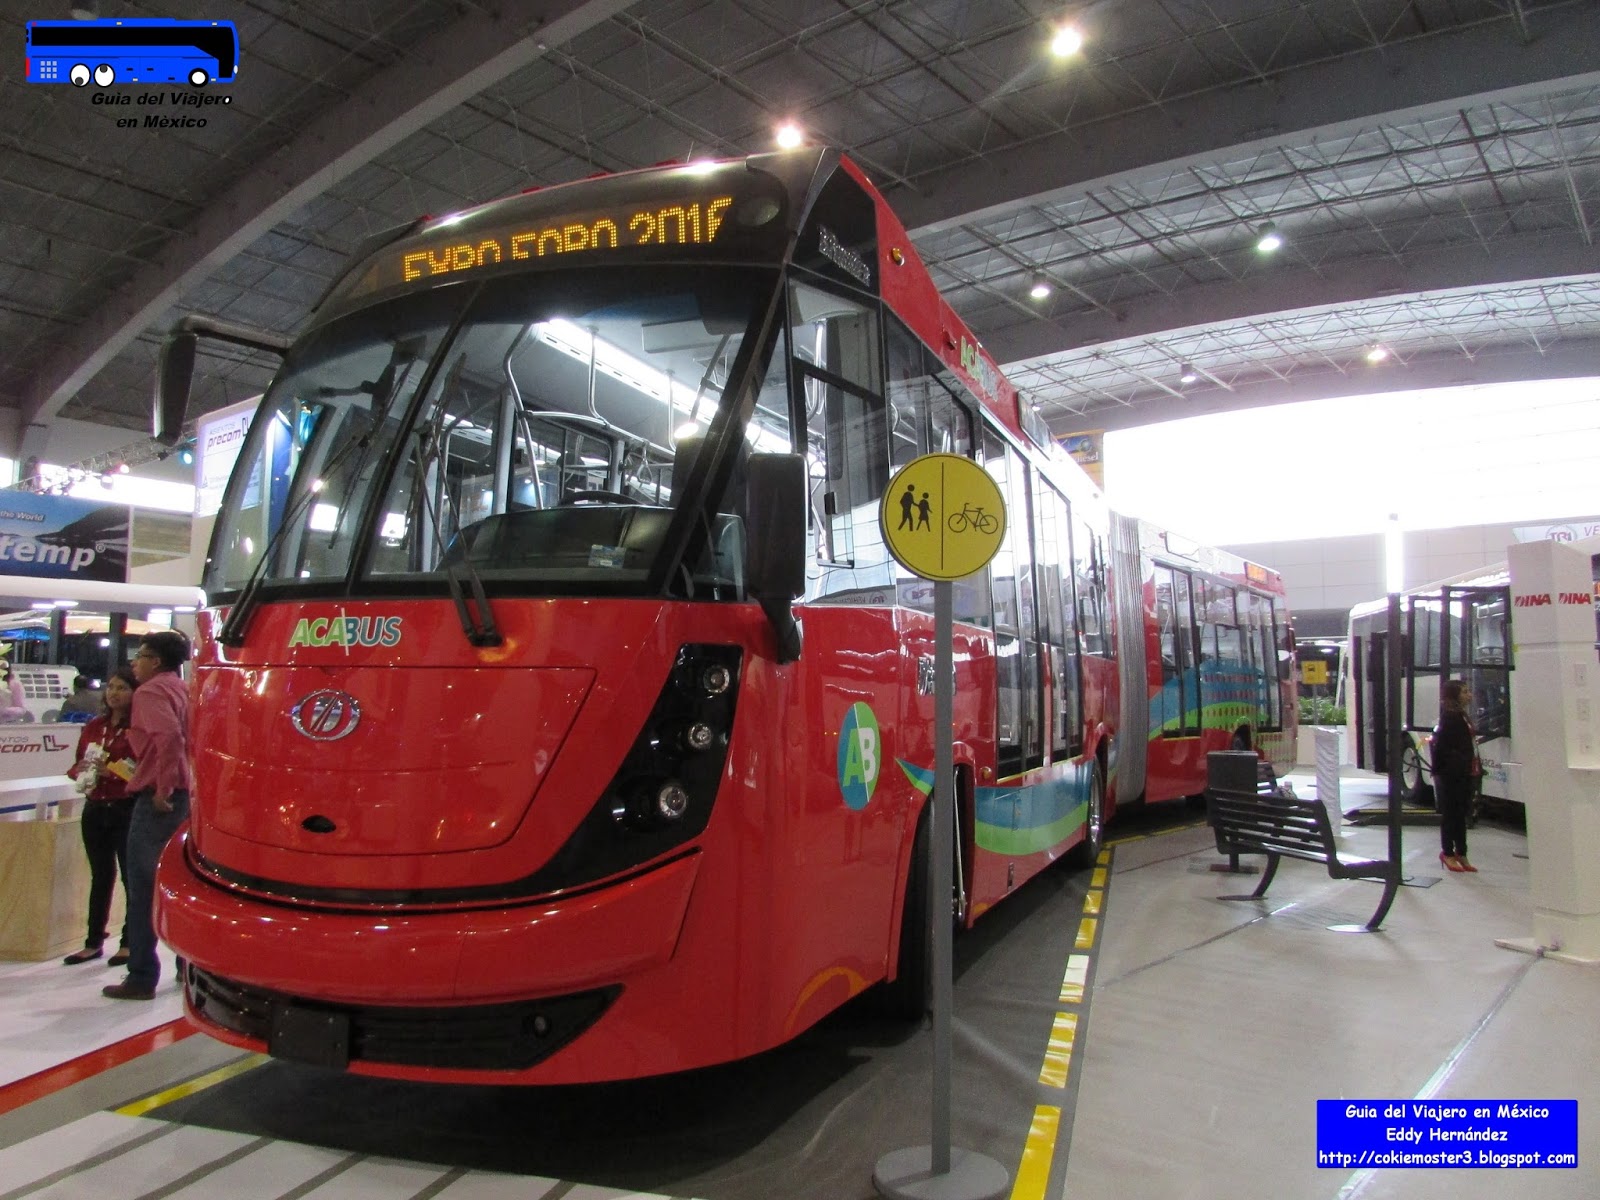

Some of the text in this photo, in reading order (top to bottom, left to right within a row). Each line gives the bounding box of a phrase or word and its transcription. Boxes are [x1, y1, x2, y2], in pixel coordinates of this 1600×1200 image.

[207, 429, 242, 451] precom
[17, 512, 44, 522] World
[1558, 592, 1592, 605] DINA
[288, 616, 403, 648] ACABUS
[843, 727, 876, 787] AB
